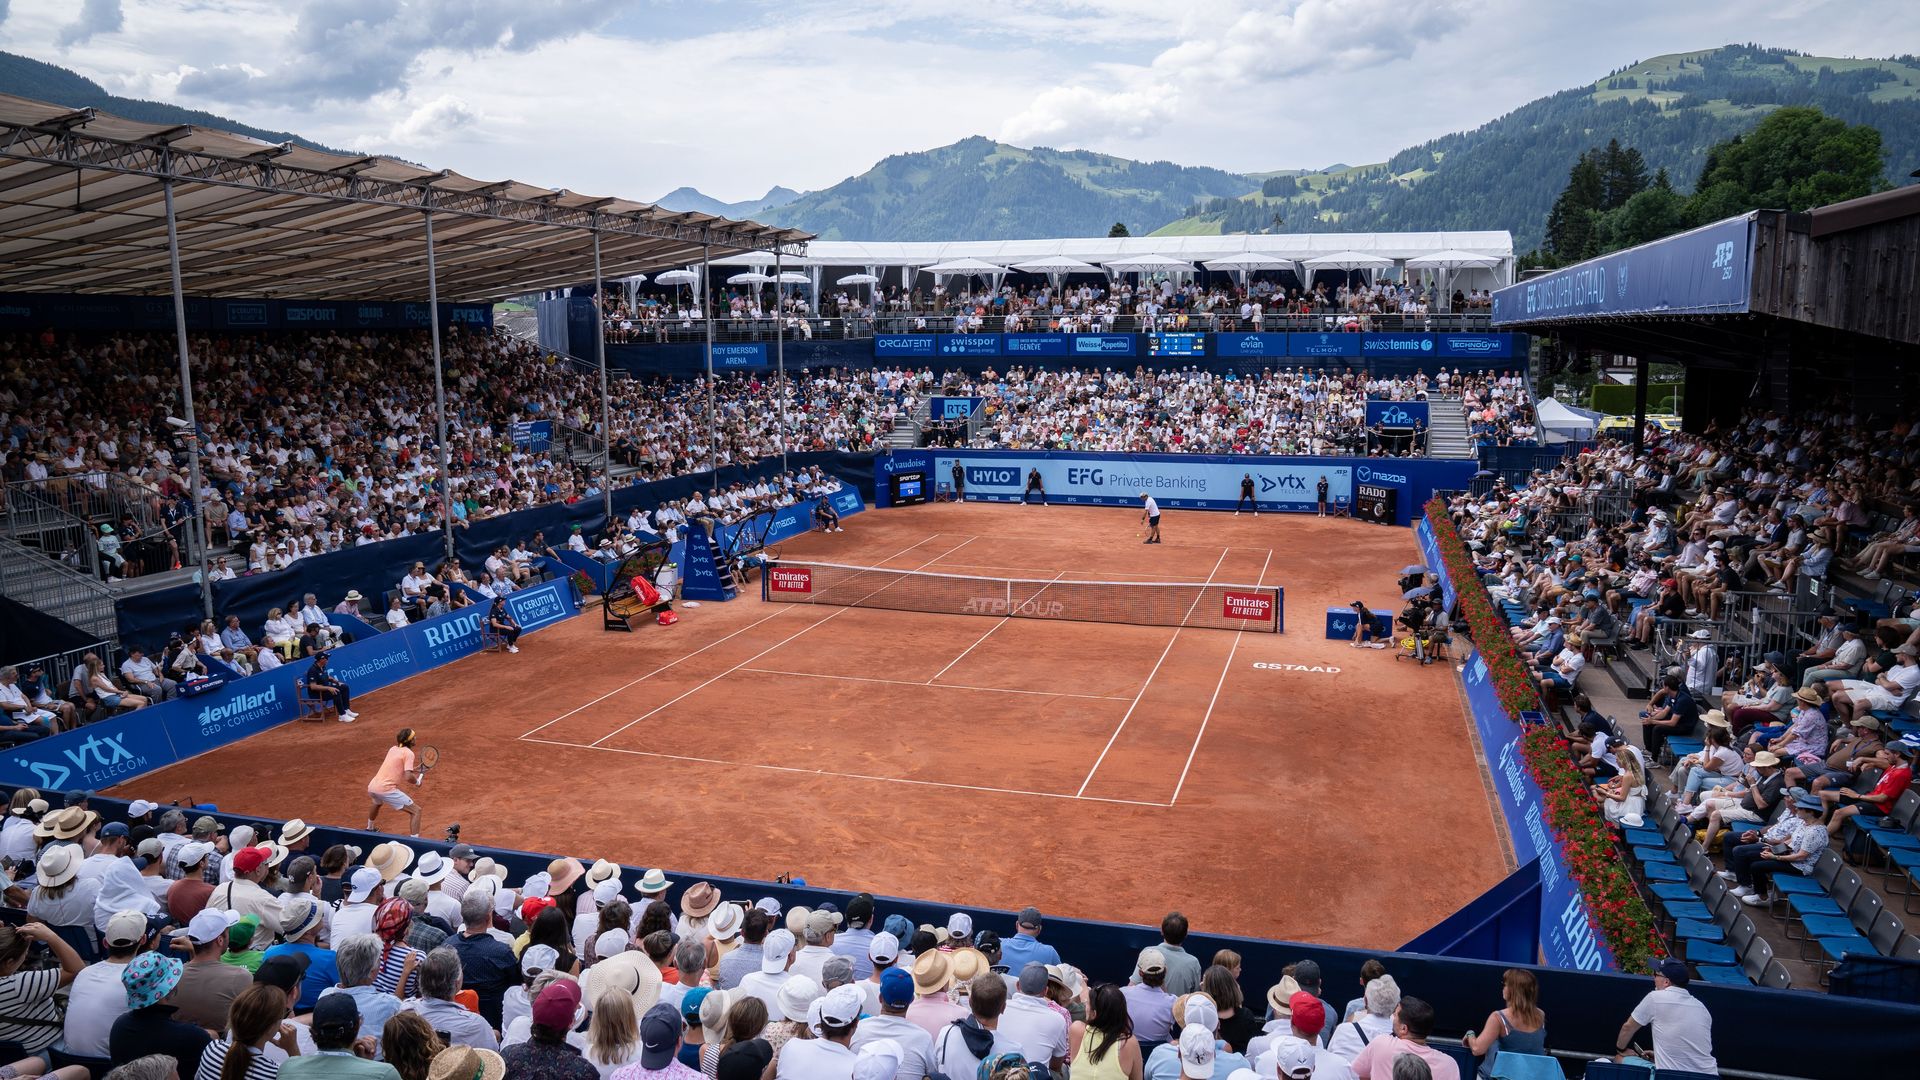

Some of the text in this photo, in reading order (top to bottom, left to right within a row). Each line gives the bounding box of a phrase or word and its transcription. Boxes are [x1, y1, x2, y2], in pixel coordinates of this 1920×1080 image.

[1712, 241, 1734, 269] ATP
[1537, 280, 1554, 311] SWISS
[1555, 275, 1573, 309] OPEN
[1575, 266, 1606, 306] GSTAAD
[300, 308, 337, 321] SPORT
[951, 336, 995, 348] swisspor
[1240, 341, 1264, 349] evian
[1364, 338, 1419, 350] swisstennis
[712, 346, 758, 355] ROY EMERSON
[725, 357, 747, 365] ARENA
[947, 404, 968, 414] RTS
[895, 458, 926, 469] vaudoise
[1068, 468, 1207, 492] EFG Private Banking
[1277, 473, 1306, 490] vtx
[1372, 472, 1407, 484] mazda
[1359, 486, 1386, 498] RADO
[775, 516, 797, 529] mazda
[702, 569, 713, 577] vtx
[773, 571, 809, 582] Emirates
[787, 581, 804, 589] BETTER
[523, 595, 550, 610] CERUTTI
[960, 597, 1064, 616] ATP TOUR
[1226, 596, 1270, 609] Emirates
[1232, 606, 1263, 616] FLY BETTER
[423, 612, 482, 648] RADO
[340, 663, 374, 682] Private
[373, 650, 410, 671] Banking
[1253, 662, 1341, 673] GSTAAD
[198, 684, 276, 726] devillard
[201, 701, 283, 737] GED COPIEURS IT
[63, 732, 135, 772] vtx
[83, 755, 149, 784] TELECOM
[1505, 755, 1526, 807] vaudoise
